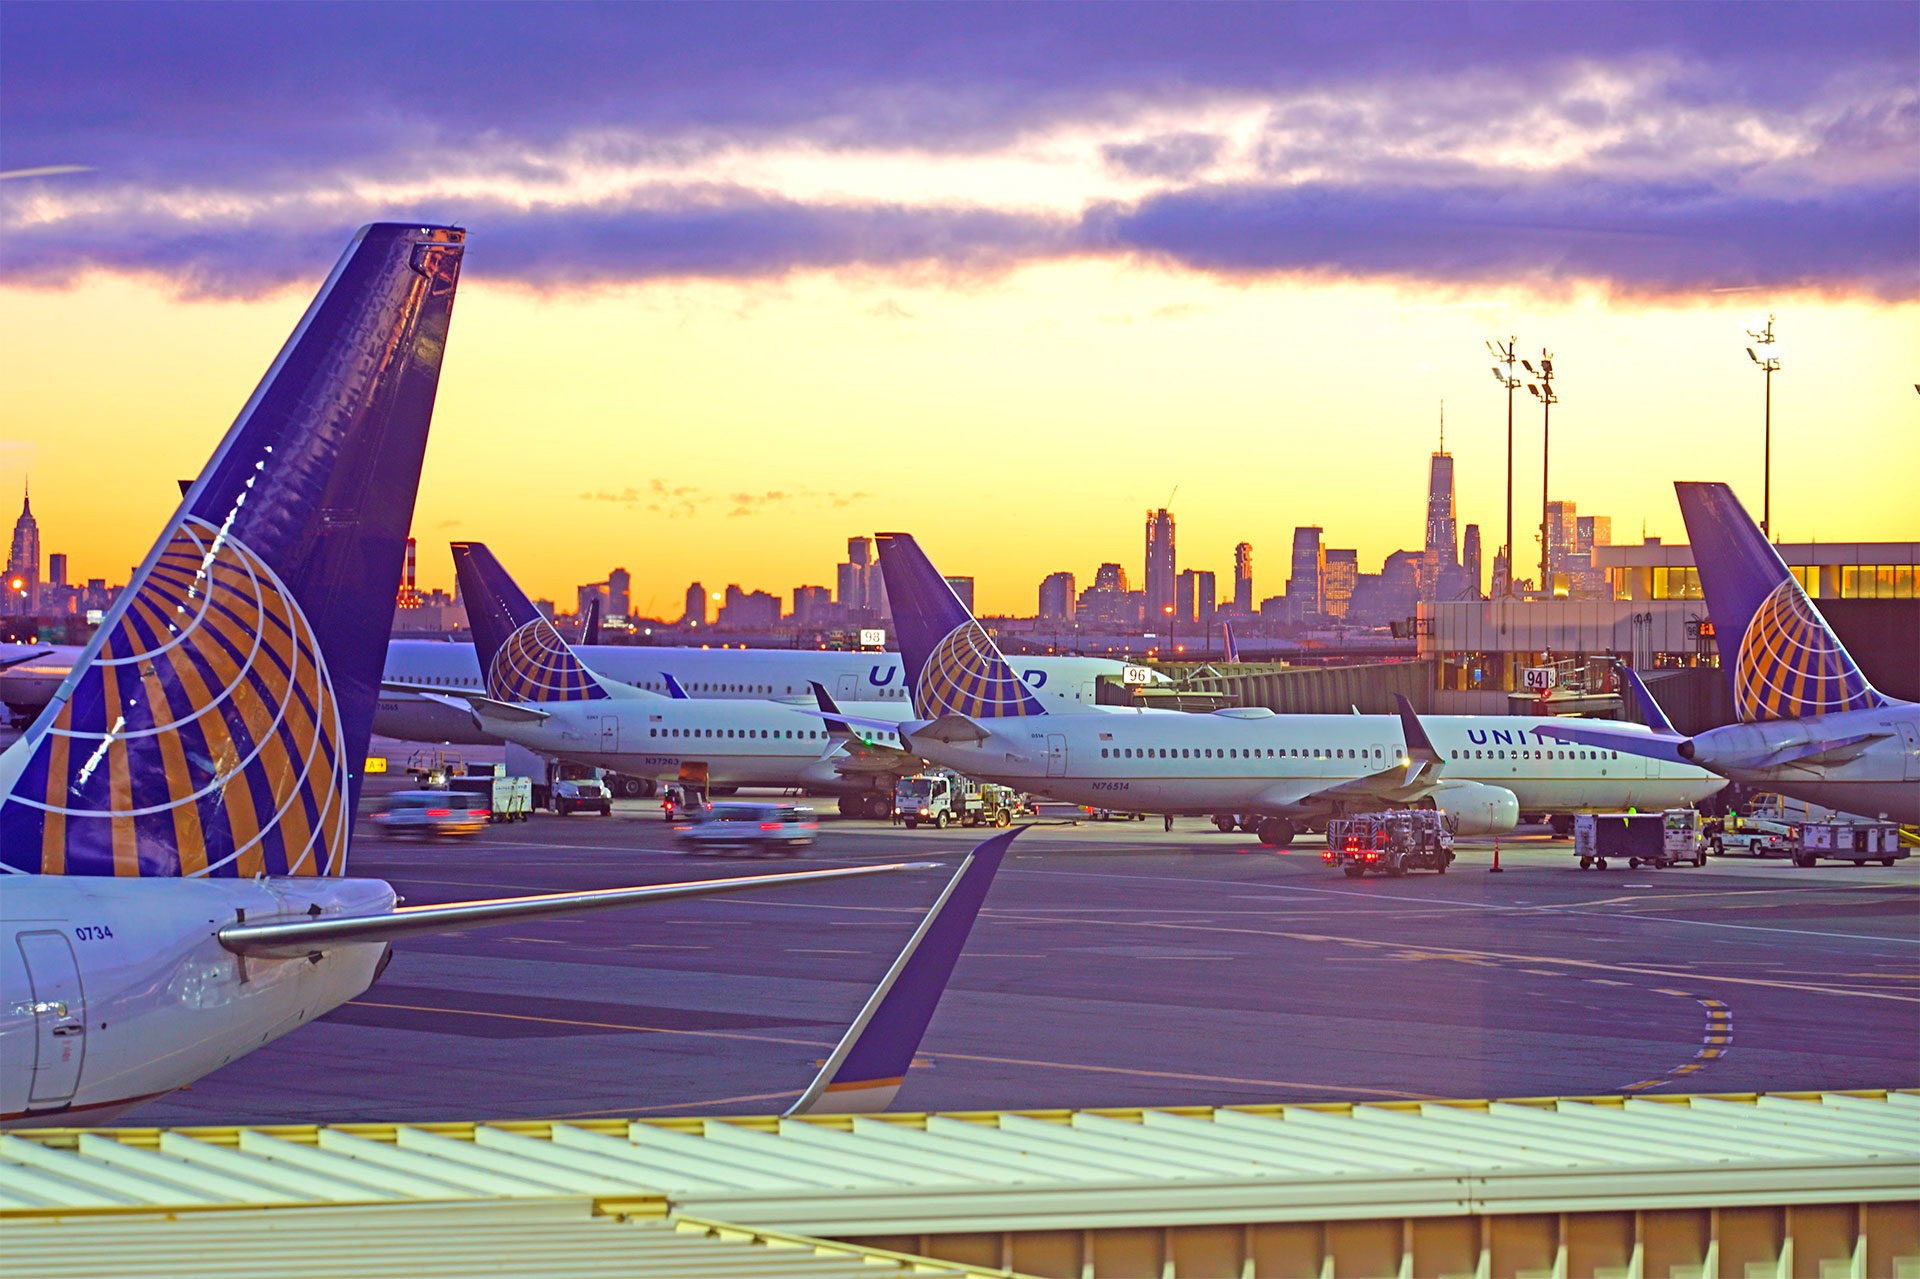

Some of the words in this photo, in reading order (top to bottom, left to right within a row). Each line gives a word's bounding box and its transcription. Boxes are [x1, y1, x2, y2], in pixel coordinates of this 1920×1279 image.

[865, 631, 880, 643] 98
[1129, 668, 1146, 682] 96
[1527, 671, 1543, 687] 94
[368, 760, 376, 769] A
[1092, 782, 1129, 791] N76514
[75, 925, 113, 941] 0734
